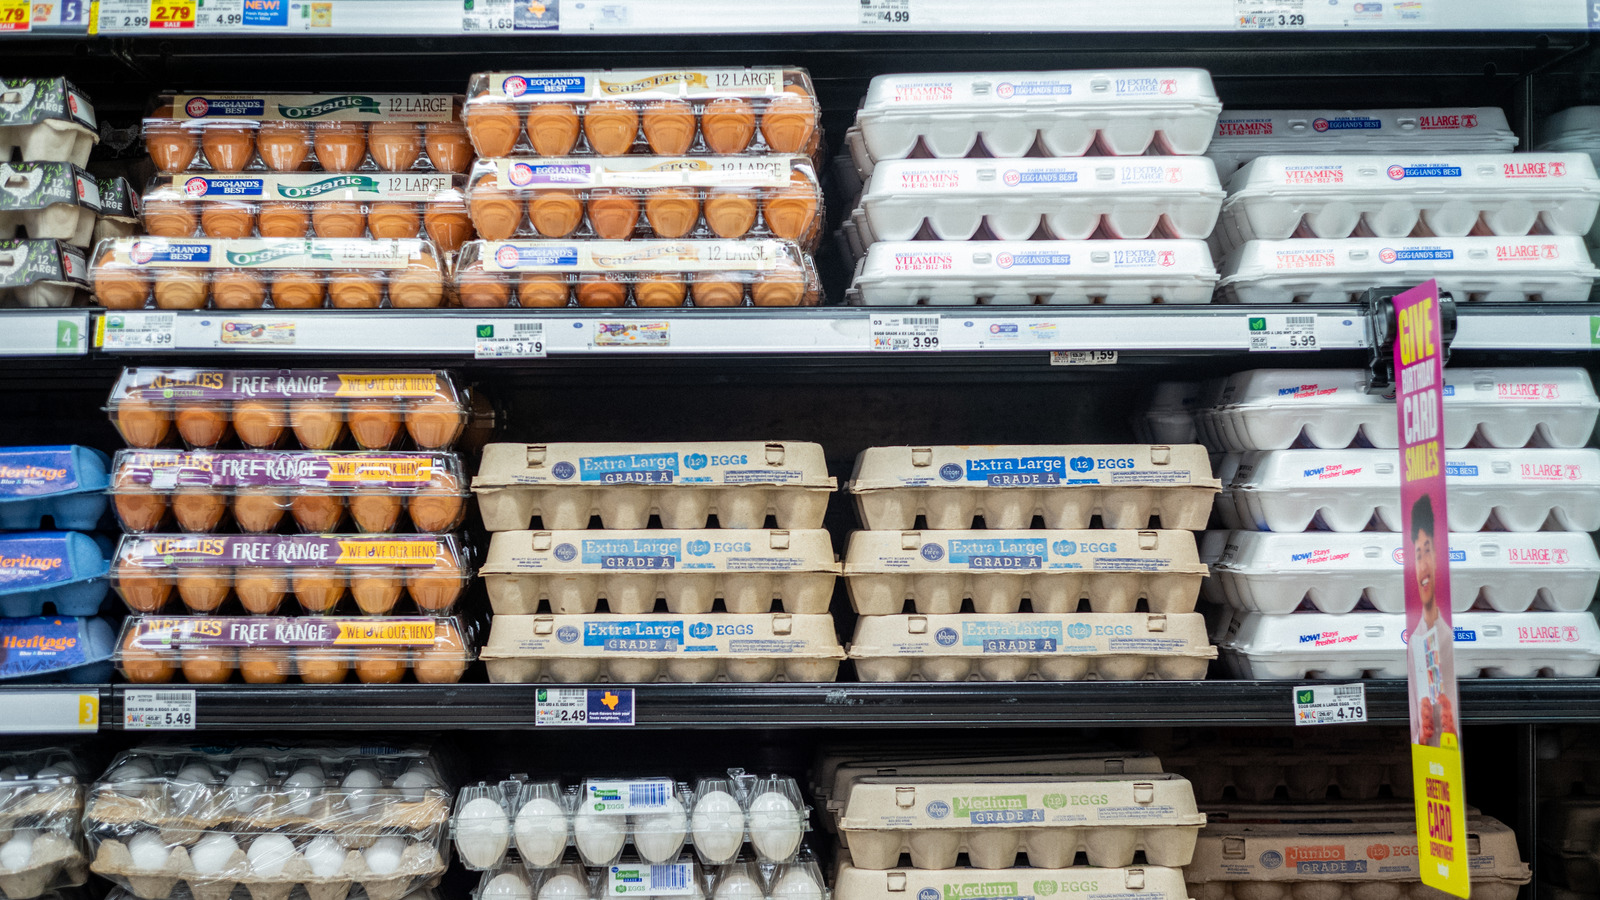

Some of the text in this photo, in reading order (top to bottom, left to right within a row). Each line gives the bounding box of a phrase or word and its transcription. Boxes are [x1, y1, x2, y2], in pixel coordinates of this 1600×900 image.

[246, 1, 280, 10] NEW!
[66, 3, 76, 20] 5
[156, 6, 190, 19] 2.79
[884, 11, 909, 22] 4.99
[124, 17, 148, 26] 2.99
[217, 14, 241, 24] 4.99
[489, 19, 512, 28] 1.69
[1279, 15, 1304, 25] 3.29
[607, 72, 694, 93] Cage Free
[716, 72, 775, 86] 12 LARGE
[544, 84, 566, 92] BEST
[896, 86, 953, 95] VITAMINS
[1051, 86, 1070, 94] BEST
[1116, 80, 1125, 92] 12
[44, 94, 56, 103] 12
[35, 101, 63, 114] LARGE
[286, 97, 362, 118] Organic
[388, 98, 446, 112] 12 LARGE
[225, 107, 247, 115] BEST
[1363, 120, 1380, 128] BEST
[1420, 115, 1459, 126] 24 LARGE
[1122, 167, 1130, 179] 12
[1286, 170, 1344, 178] VITAMINS
[1504, 163, 1547, 174] 24 LARGE
[902, 174, 959, 182] VITAMINS
[1057, 173, 1076, 181] BEST
[52, 180, 63, 188] 12
[285, 176, 361, 198] Organic
[388, 178, 445, 192] 12 LARGE
[42, 186, 71, 199] LARGE
[224, 186, 247, 194] BEST
[1114, 251, 1123, 263] 12
[1435, 250, 1452, 258] BEST
[1497, 246, 1539, 257] 24 LARGE
[896, 256, 952, 264] VITAMINS
[1050, 255, 1069, 264] BEST
[27, 262, 57, 275] LARGE
[62, 328, 71, 346] 4
[1399, 297, 1434, 366] GIVE
[146, 334, 171, 343] 4.99
[913, 337, 938, 347] 3.99
[1290, 336, 1316, 347] 5.99
[517, 342, 542, 352] 3.79
[1090, 351, 1114, 360] 1.59
[1401, 358, 1435, 394] BIRTHDAY
[232, 376, 328, 396] FREE RANGE
[1317, 387, 1338, 396] Longer
[1498, 384, 1540, 396] 18 LARGE
[1404, 388, 1437, 444] CARD
[584, 456, 676, 472] Extra Large
[711, 455, 748, 465] EGGS
[971, 459, 1062, 472] Extra Large
[1097, 459, 1134, 469] EGGS
[1405, 441, 1439, 482] SMILES
[222, 459, 317, 479] FREE RANGE
[1521, 464, 1563, 476] 18 LARGE
[605, 472, 669, 482] GRADE A
[992, 474, 1055, 484] GRADE A
[233, 543, 329, 562] FREE RANGE
[349, 545, 434, 557] WE OUR HENS
[586, 541, 678, 554] Extra Large
[714, 542, 751, 552] EGGS
[952, 542, 1044, 554] Extra Large
[1080, 542, 1118, 552] EGGS
[1509, 548, 1550, 560] 18 LARGE
[0, 555, 62, 570] eritage
[606, 558, 670, 568] GRADE A
[974, 557, 1037, 567] GRADE A
[231, 623, 327, 644] FREE RANGE
[588, 623, 680, 636] Extra Large
[716, 625, 753, 635] EGGS
[966, 624, 1058, 636] Extra Large
[1095, 626, 1132, 635] EGGS
[1518, 627, 1560, 638] 18 LARGE
[4, 636, 76, 650] Heritage
[609, 640, 672, 649] GRADE A
[988, 640, 1052, 650] GRADE A
[85, 703, 93, 722] 3
[561, 710, 585, 720] 2.49
[1337, 707, 1362, 718] 4.79
[165, 713, 191, 724] 5.49
[1426, 777, 1450, 802] GREETING
[958, 796, 1022, 810] Medium
[1070, 794, 1108, 805] EGGS
[976, 811, 1040, 822] GRADE A
[1428, 801, 1452, 842] CARD
[1290, 847, 1340, 859] Jumbo
[1392, 846, 1418, 856] EGG
[1302, 862, 1363, 872] GRADE A
[948, 884, 1013, 896] Medium
[1060, 882, 1098, 892] EGGS
